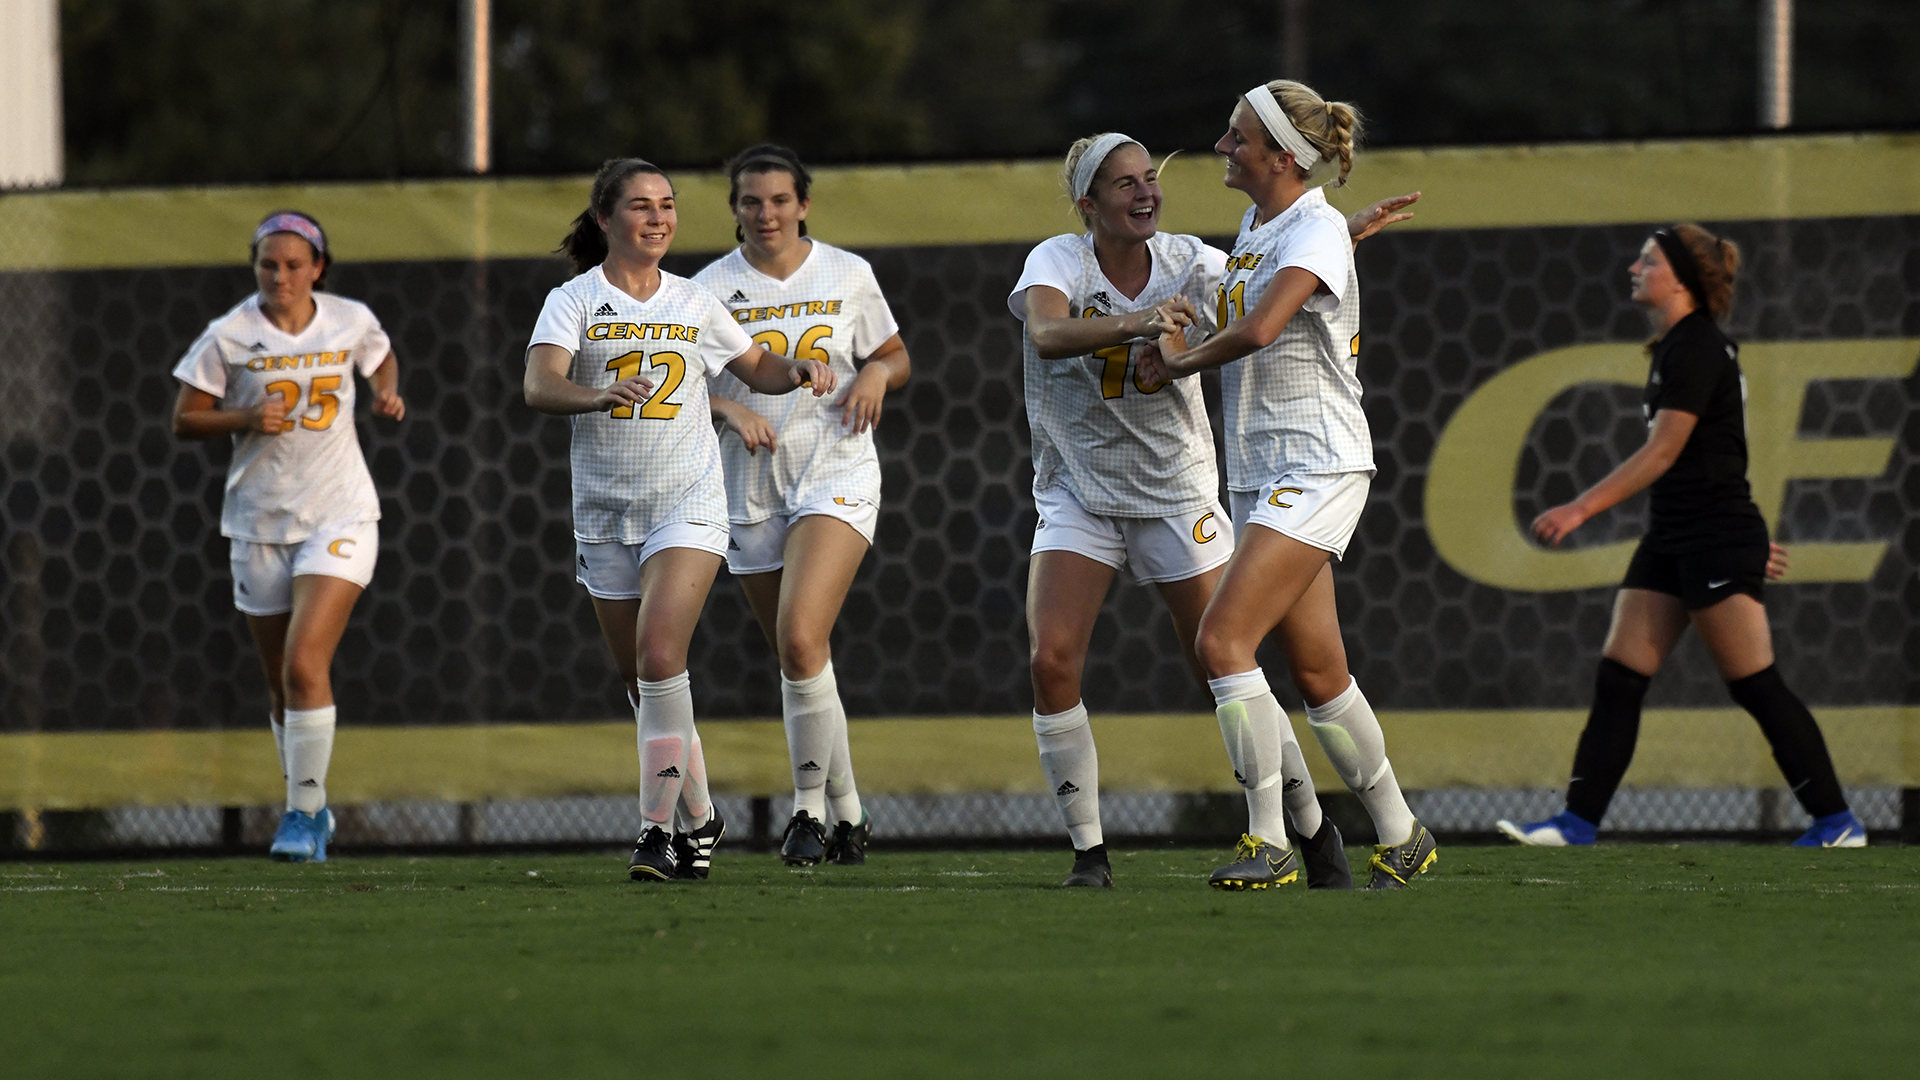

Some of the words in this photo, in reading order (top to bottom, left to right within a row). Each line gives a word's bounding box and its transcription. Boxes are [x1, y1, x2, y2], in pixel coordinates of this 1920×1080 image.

[731, 300, 843, 325] CENTRE
[586, 322, 700, 344] CENTRE
[248, 350, 350, 372] CENTRE
[605, 350, 687, 420] 12
[265, 374, 342, 434] 25
[1267, 487, 1303, 509] C
[1192, 512, 1217, 544] C
[328, 538, 357, 560] C
